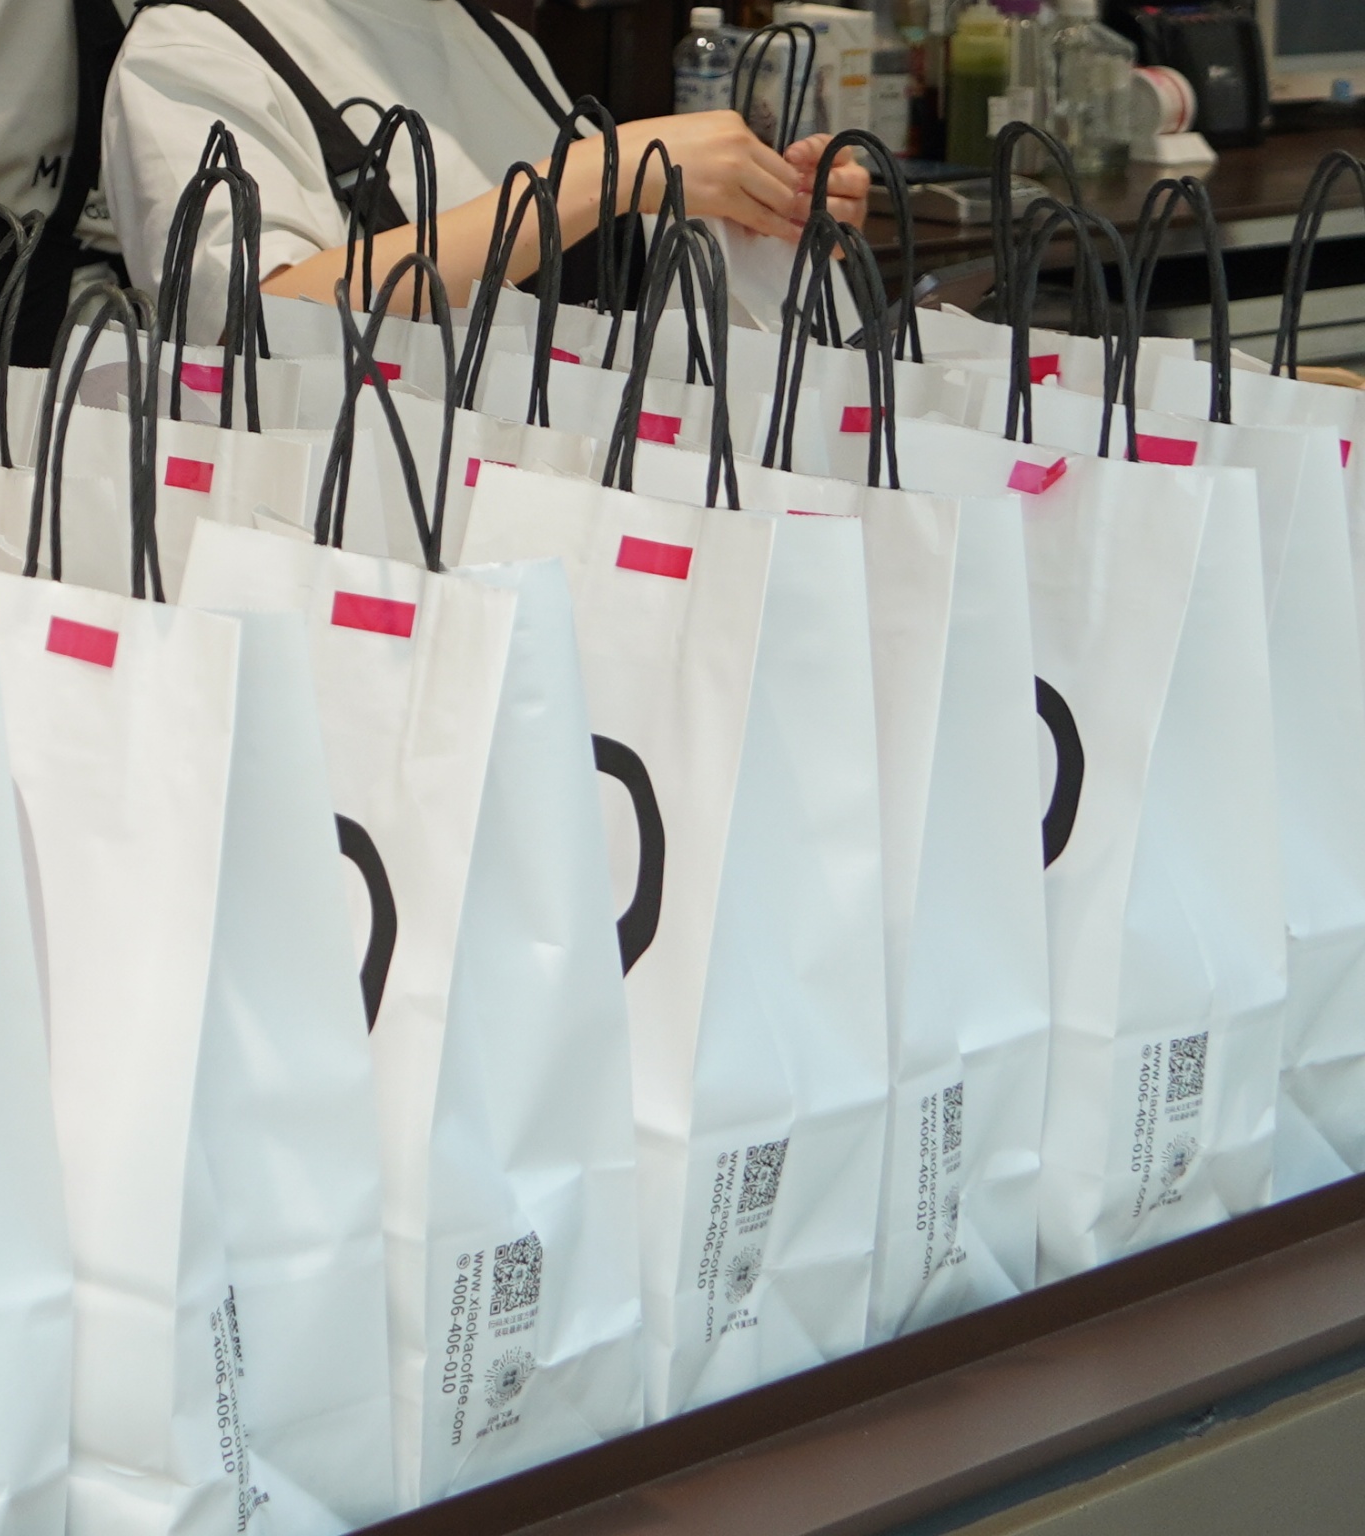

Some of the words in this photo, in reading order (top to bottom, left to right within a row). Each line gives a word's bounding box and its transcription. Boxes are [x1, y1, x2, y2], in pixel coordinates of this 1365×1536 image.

[916, 1116, 929, 1231] 4006-406-010
[1131, 1063, 1150, 1173] 4006-406-010
[697, 1172, 724, 1289] 4006-406-010
[442, 1274, 468, 1394] 4006-406-010
[452, 1250, 484, 1446] www.xiaokacoffee.com
[213, 1336, 235, 1473] 4006-406-010
